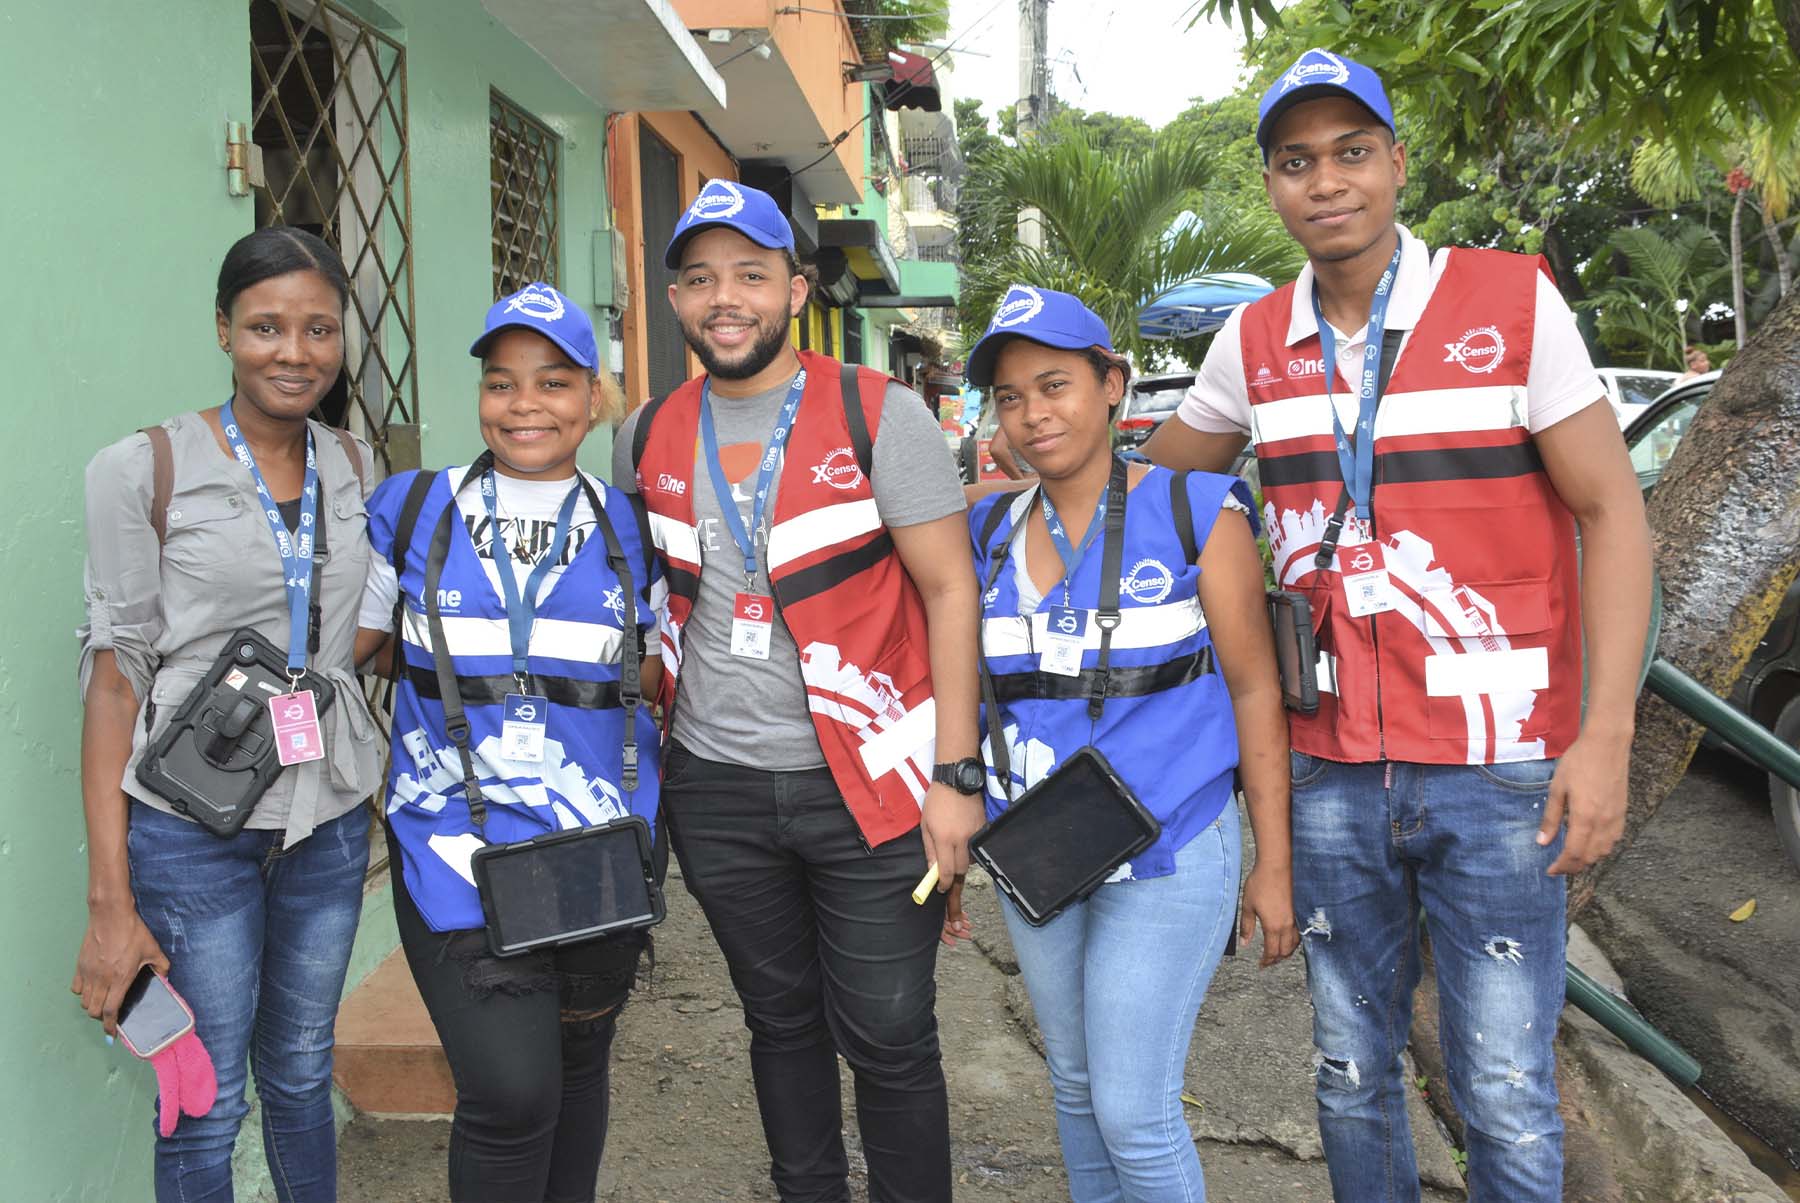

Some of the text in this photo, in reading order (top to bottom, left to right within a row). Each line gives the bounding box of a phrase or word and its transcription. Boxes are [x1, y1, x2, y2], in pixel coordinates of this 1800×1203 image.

[1462, 346, 1497, 357] Censo
[827, 464, 857, 477] Censo
[1132, 577, 1165, 589] Censo
